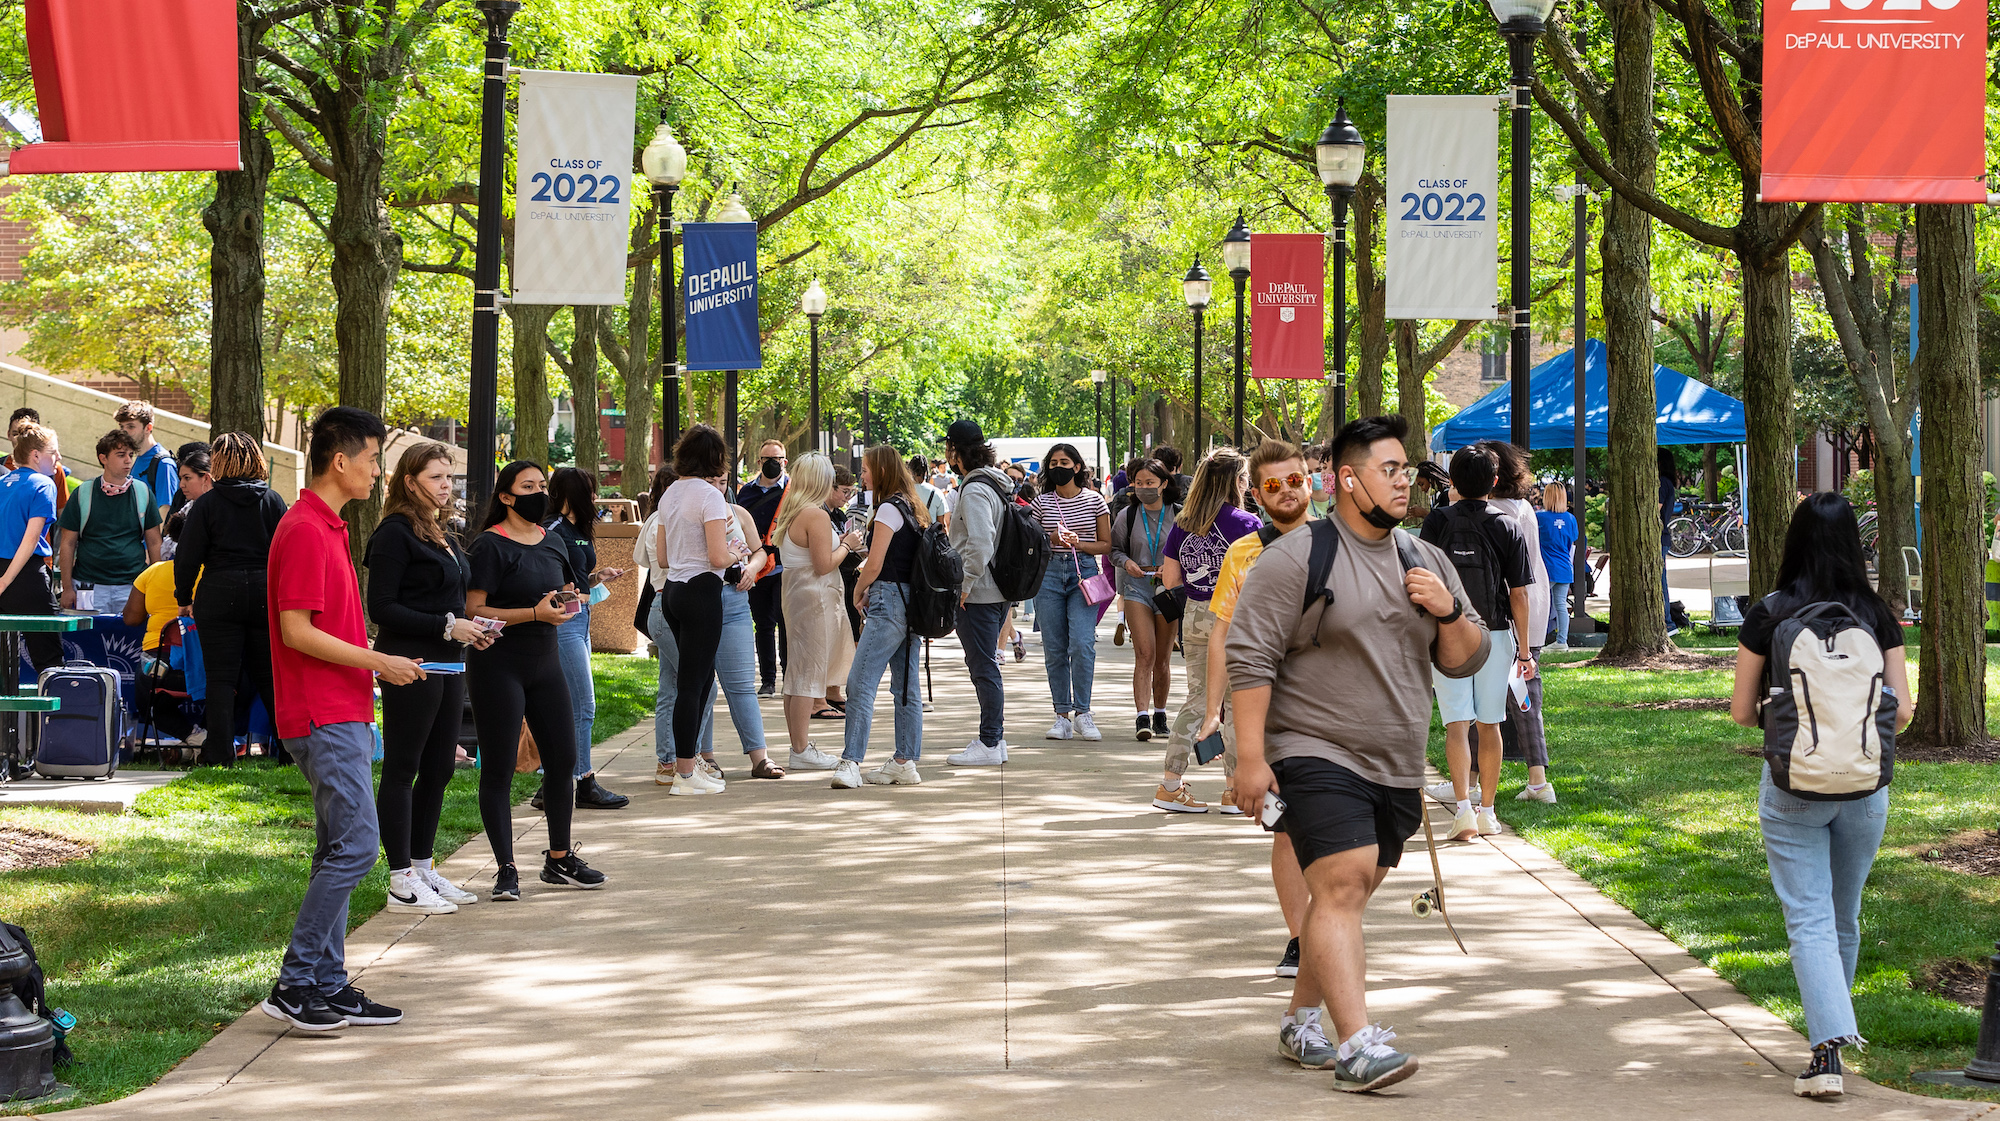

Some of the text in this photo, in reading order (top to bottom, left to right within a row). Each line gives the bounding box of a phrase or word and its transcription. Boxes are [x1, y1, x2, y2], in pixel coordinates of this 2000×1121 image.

[1856, 33, 1965, 50] UNIVERSITY
[550, 158, 602, 169] CLASS OF
[530, 172, 620, 204] 2022
[1418, 179, 1468, 189] CLASS OF
[1400, 192, 1486, 221] 2022
[564, 213, 616, 222] UNIVERSITY
[1433, 230, 1483, 239] UNIVERSITY
[689, 283, 754, 315] UNIVERSITY
[1257, 292, 1317, 304] UNIVERSITY
